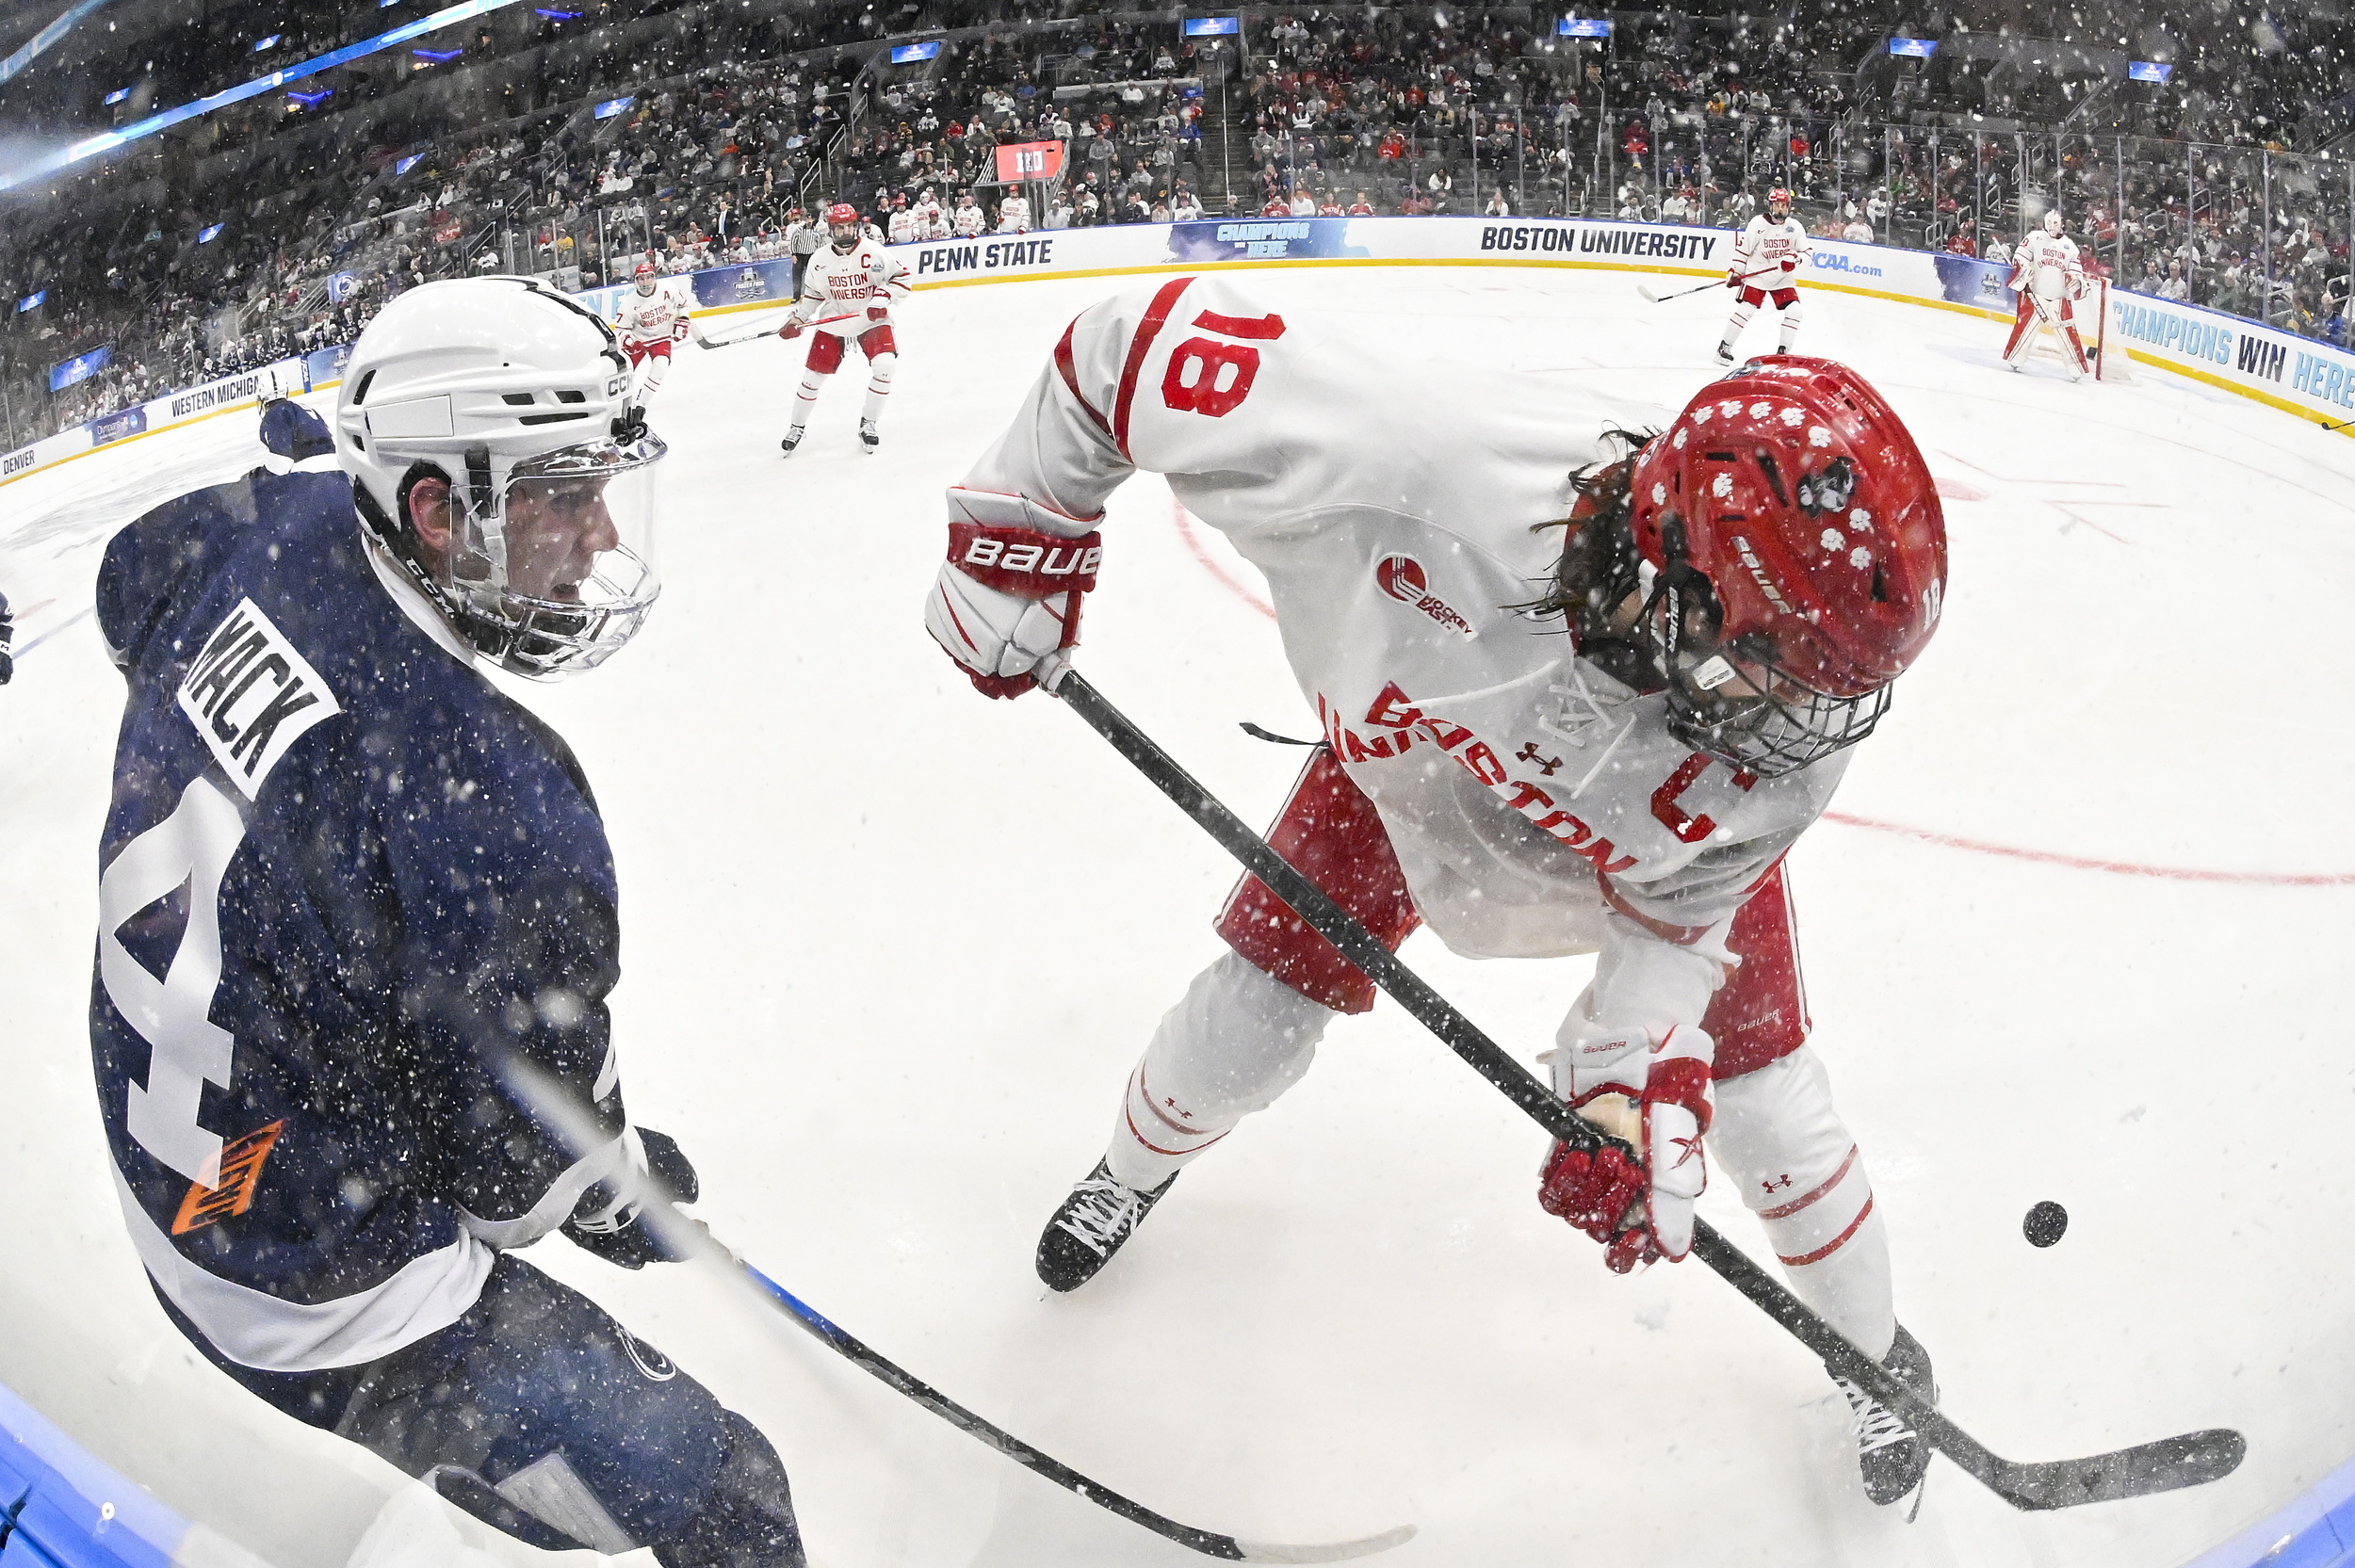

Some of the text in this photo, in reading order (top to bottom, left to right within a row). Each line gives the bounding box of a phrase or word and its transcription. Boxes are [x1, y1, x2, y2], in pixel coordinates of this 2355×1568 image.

[1217, 222, 1309, 242] CHAMPIONS
[1481, 226, 1717, 261] BOSTON UNIVERSITY
[1763, 238, 1790, 248] BOSTON
[860, 253, 871, 269] C
[918, 239, 1053, 274] PENN STATE
[1247, 240, 1288, 258] HERE
[2042, 248, 2066, 260] BOSTON
[827, 272, 868, 287] BOSTON
[663, 290, 672, 301] A
[640, 304, 667, 320] BOSTON
[1161, 309, 1288, 418] 18
[2237, 334, 2287, 382] WIN
[2292, 350, 2355, 409] HERE
[171, 375, 259, 417] WESTERN MICHIGA
[3, 449, 36, 475] DENVER
[406, 557, 456, 616] CCM
[185, 609, 320, 780] MACK
[99, 775, 247, 1193] 4
